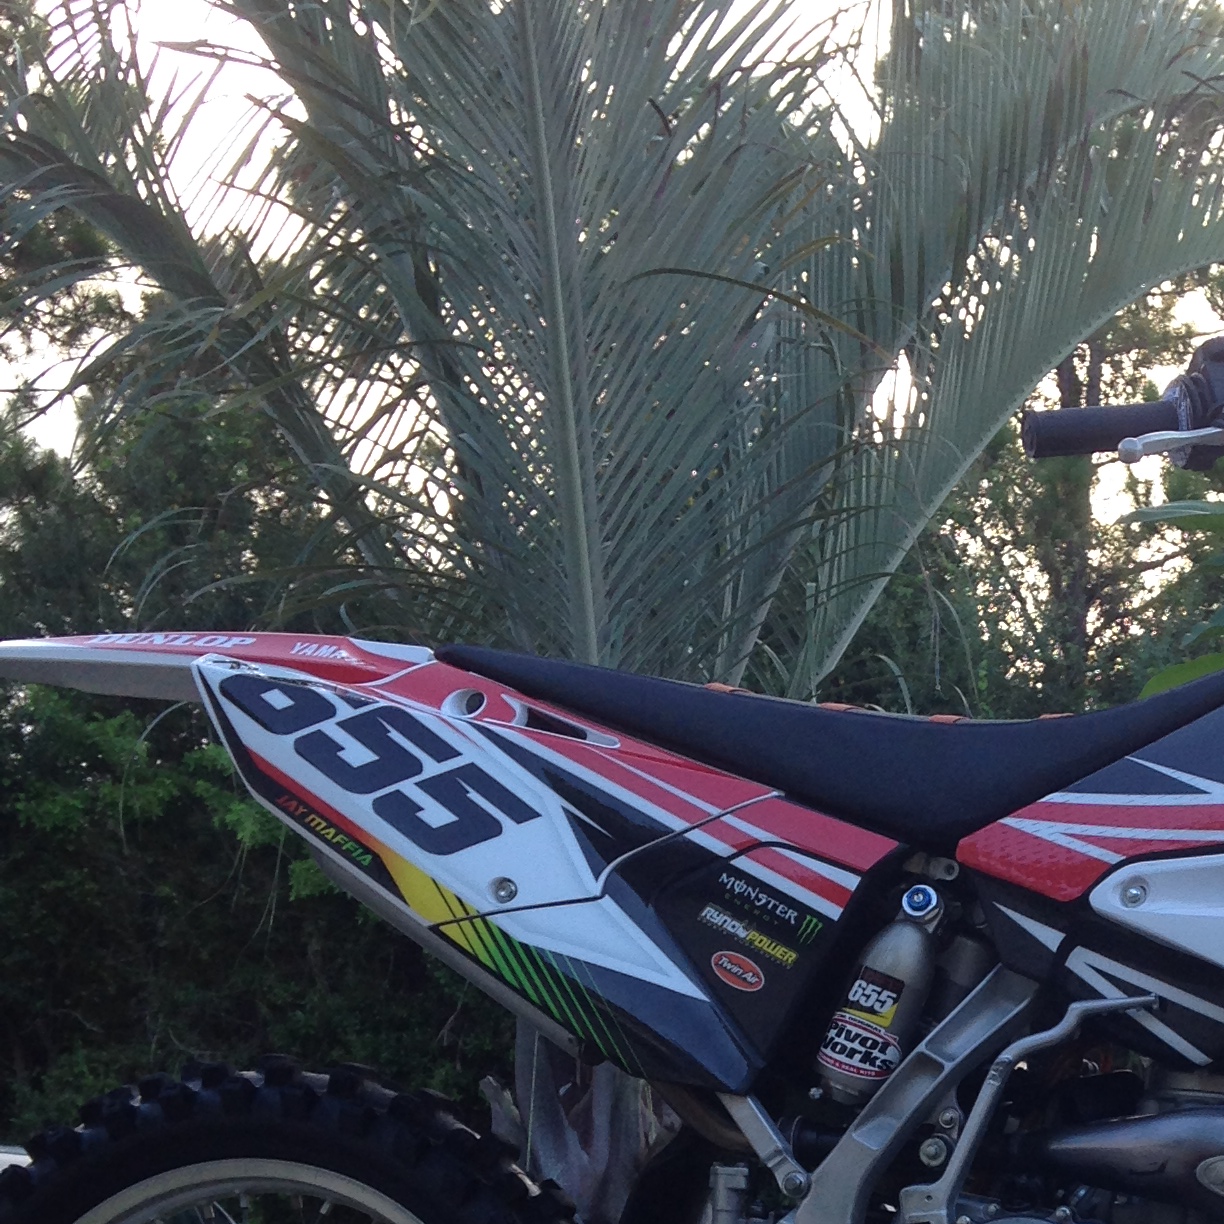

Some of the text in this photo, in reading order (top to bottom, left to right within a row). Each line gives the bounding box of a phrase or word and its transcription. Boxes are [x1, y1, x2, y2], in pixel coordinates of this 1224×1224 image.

[87, 633, 257, 648] DUNLOP
[275, 795, 373, 866] JAY MAFFIA
[719, 872, 799, 925] MONSTER
[718, 955, 760, 984] Twin Air
[847, 978, 898, 1014] 655
[828, 1022, 893, 1056] Pivot
